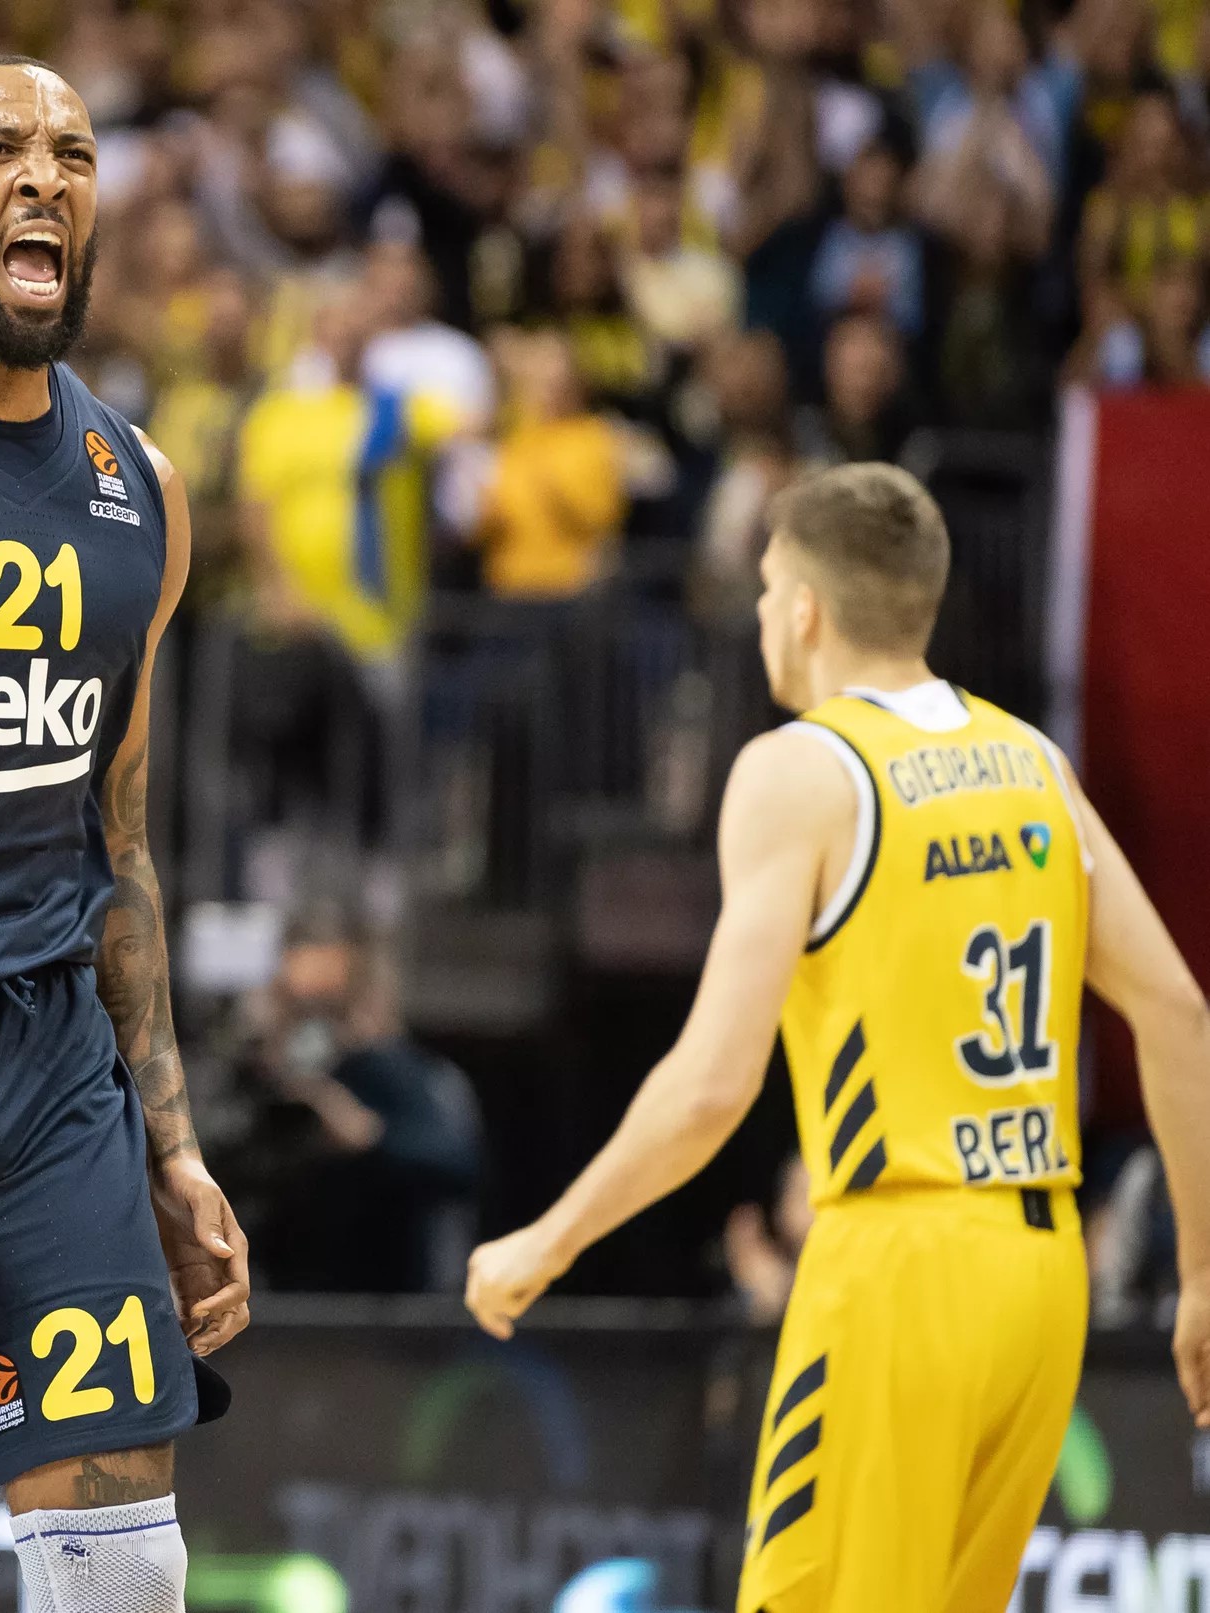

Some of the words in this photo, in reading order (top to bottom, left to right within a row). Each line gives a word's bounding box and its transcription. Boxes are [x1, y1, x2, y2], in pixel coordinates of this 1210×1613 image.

[90, 500, 140, 527] oneteam
[924, 833, 1013, 883] ALBA
[956, 921, 1055, 1084] 31
[31, 1295, 155, 1421] 21
